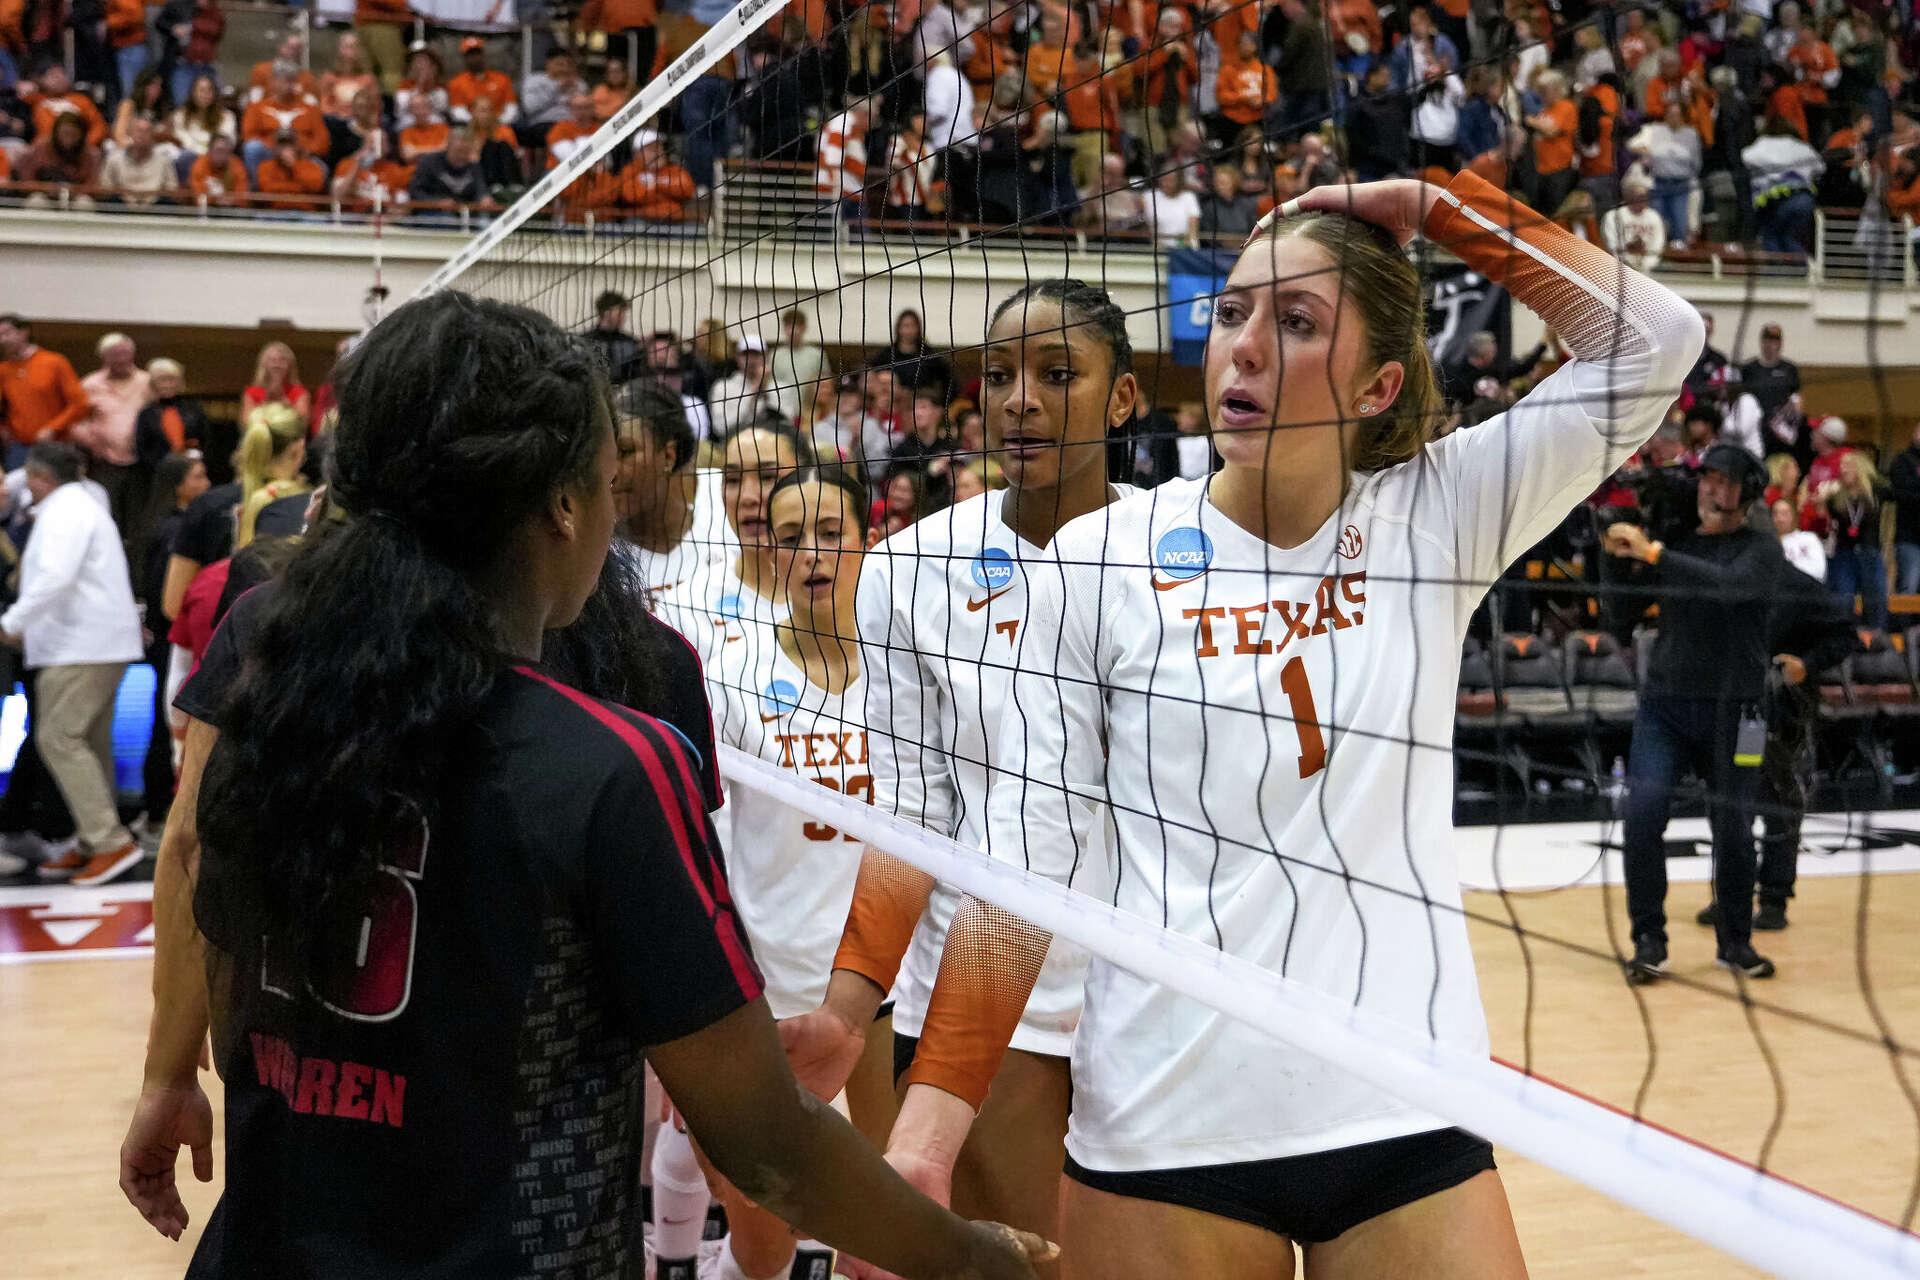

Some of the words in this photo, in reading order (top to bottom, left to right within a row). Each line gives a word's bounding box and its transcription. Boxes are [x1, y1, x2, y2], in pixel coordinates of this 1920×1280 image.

[1163, 551, 1208, 565] NCAA
[1182, 570, 1366, 658] TEXAS
[1280, 656, 1327, 779] 1
[529, 1138, 574, 1158] BRING
